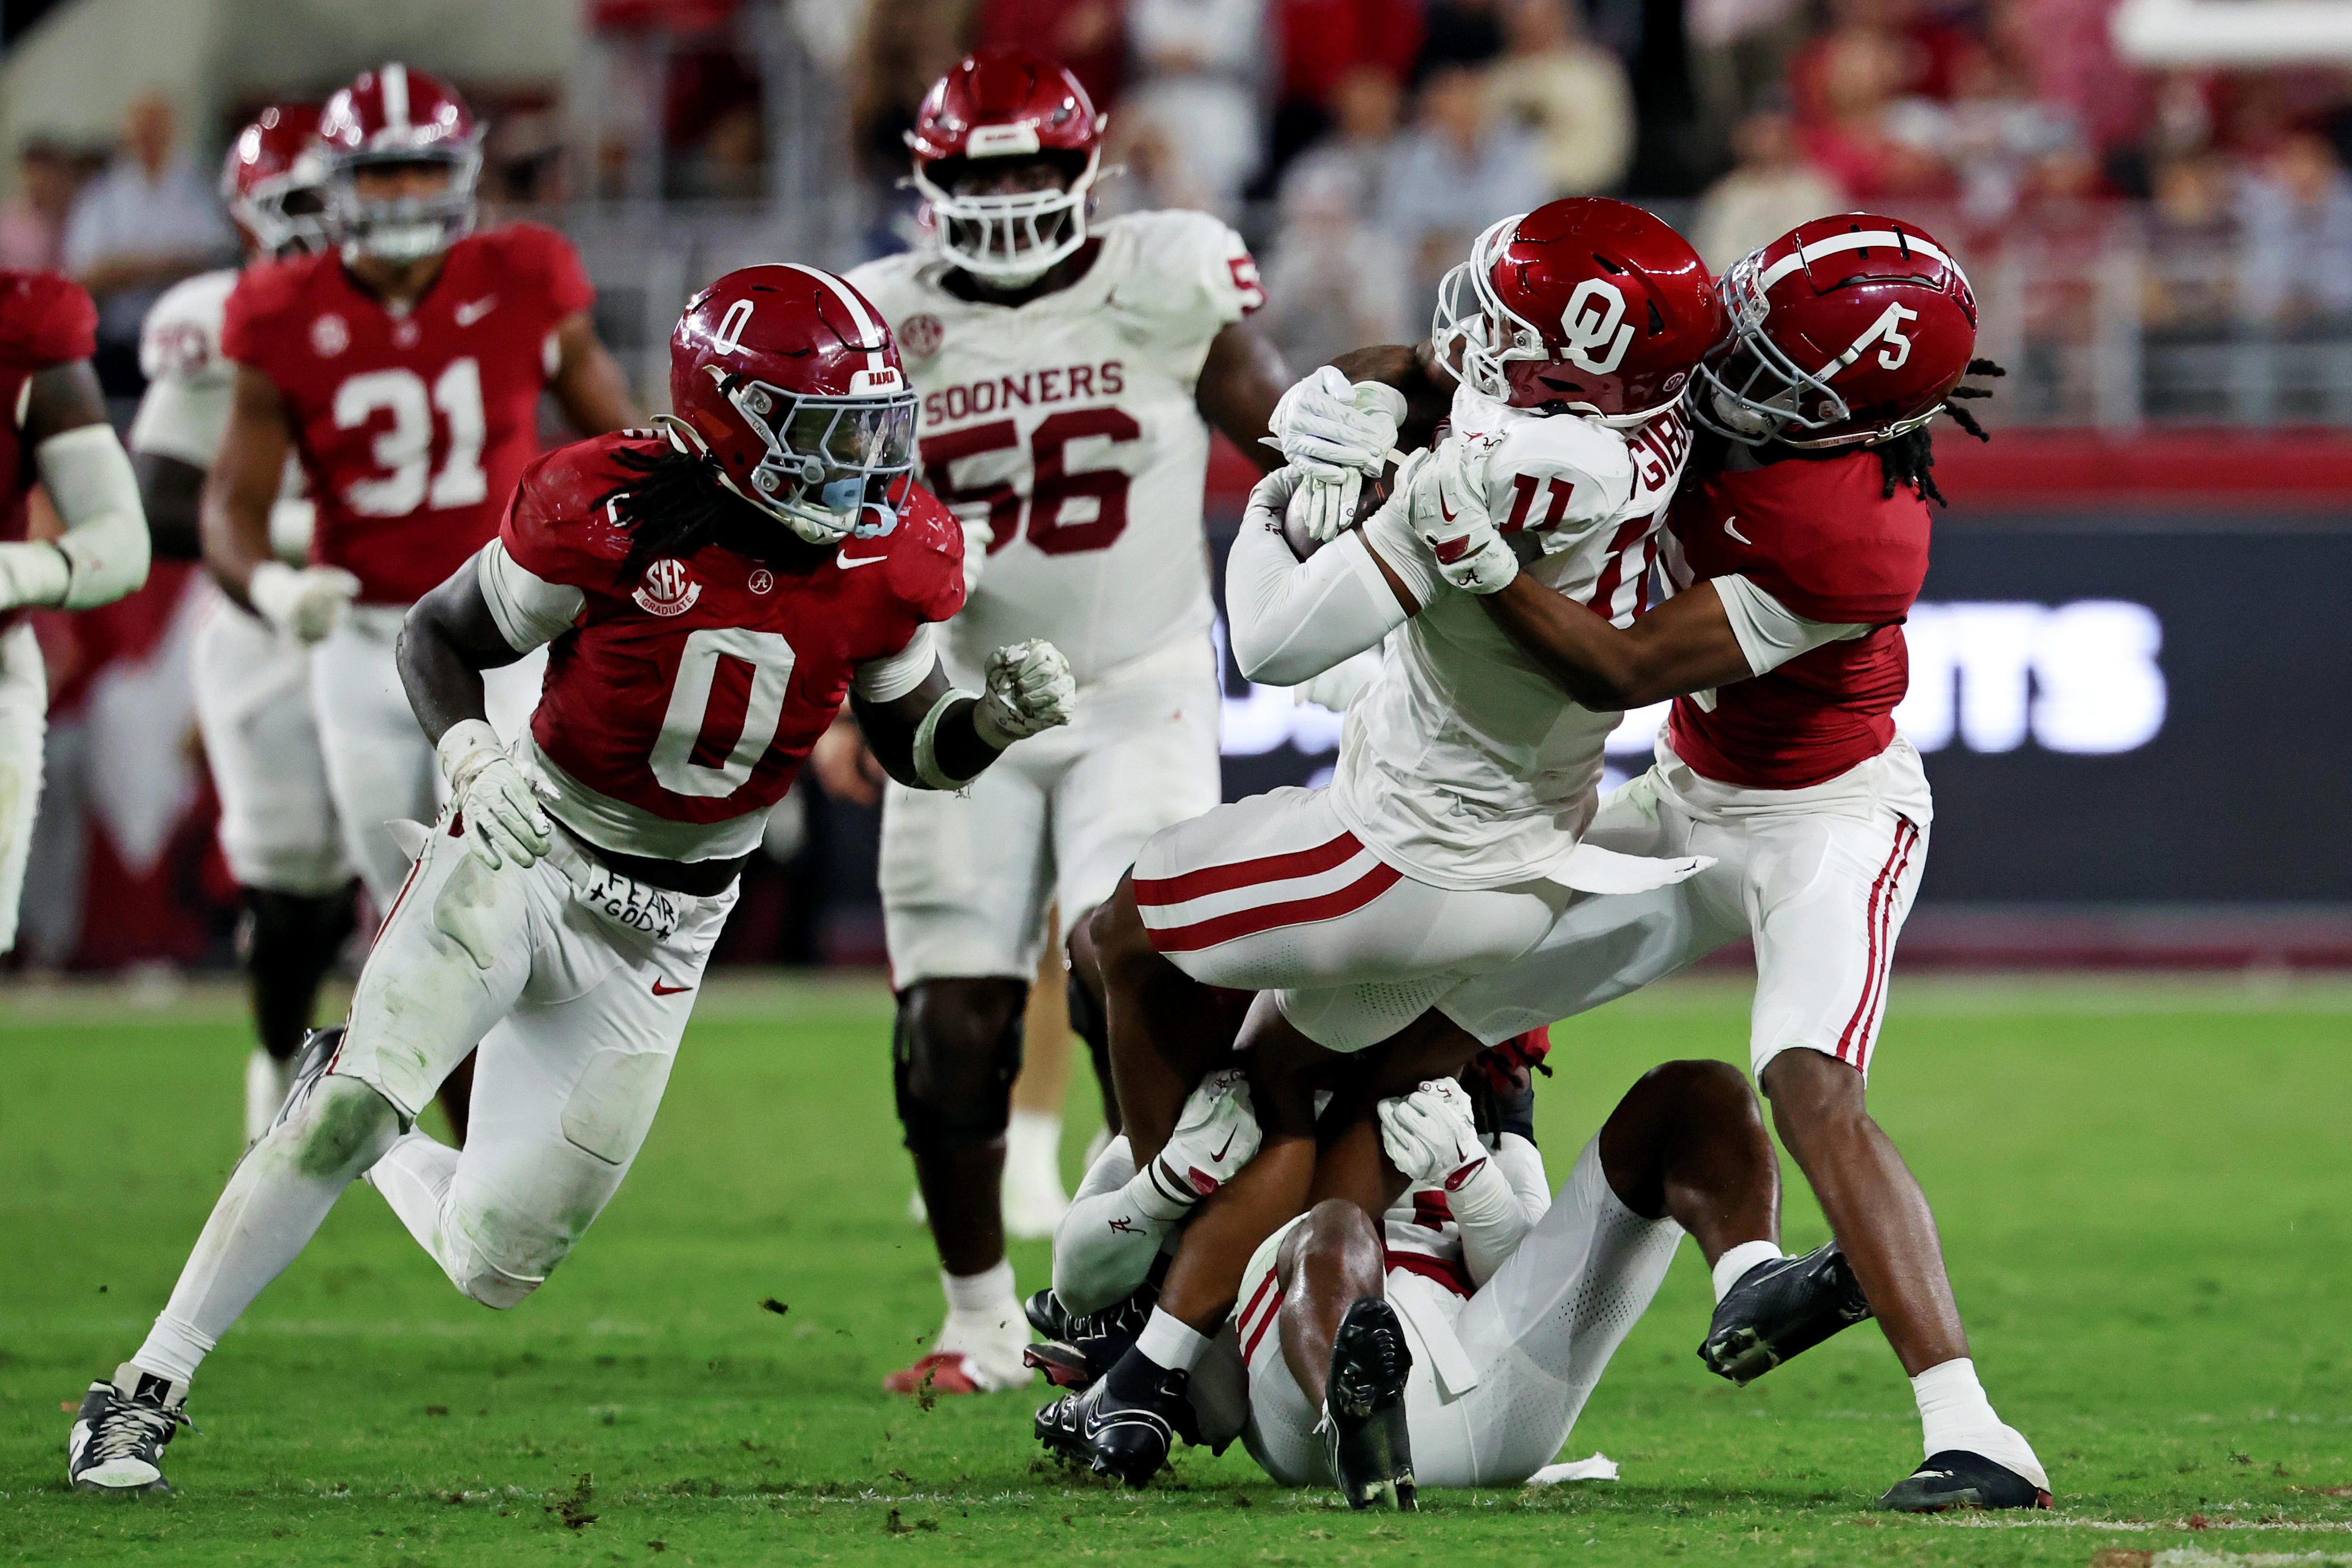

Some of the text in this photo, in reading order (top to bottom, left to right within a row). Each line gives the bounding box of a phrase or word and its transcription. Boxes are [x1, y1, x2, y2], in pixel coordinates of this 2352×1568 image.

[714, 299, 754, 355] 0
[1877, 302, 1918, 370] 5
[868, 371, 895, 386] BAMA
[925, 361, 1125, 426] SOONERS
[333, 356, 489, 518] 31
[918, 406, 1140, 557] 56
[1499, 472, 1575, 534] 11
[642, 595, 694, 615] GRADUATE
[646, 559, 687, 600] SEC
[649, 627, 796, 799] 0
[604, 898, 654, 931] GOD
